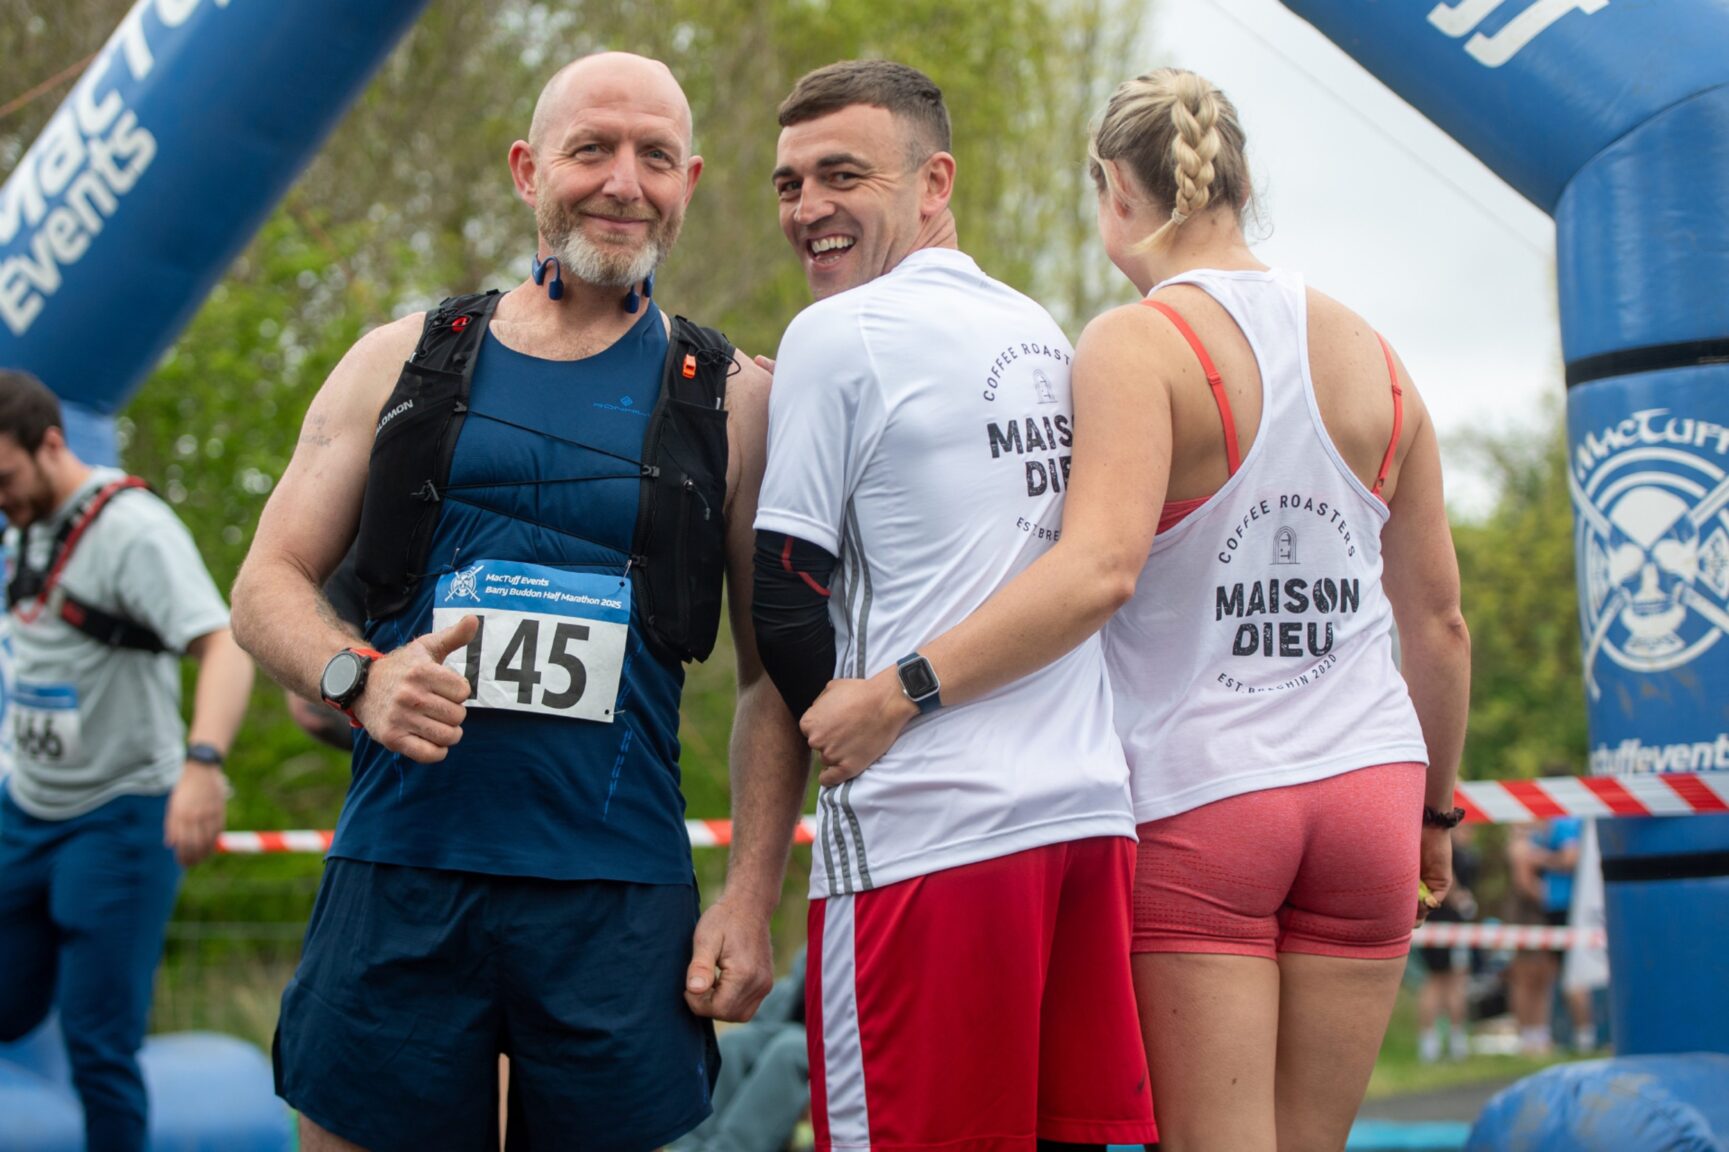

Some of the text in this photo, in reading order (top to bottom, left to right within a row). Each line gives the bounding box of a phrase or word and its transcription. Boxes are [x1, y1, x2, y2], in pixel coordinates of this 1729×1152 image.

[0, 109, 158, 336] Events
[983, 343, 1073, 402] COFFEE ROAST
[986, 414, 1074, 458] MAIS
[1218, 494, 1356, 564] COFFEE ROASTERS
[485, 573, 549, 587] MacTuff Events
[485, 586, 622, 609] Barry Buddon Half Marathon 2025
[1215, 577, 1360, 621] MAISON
[1232, 621, 1334, 657] DIEU
[464, 614, 591, 709] 145
[1312, 653, 1337, 680] 2020
